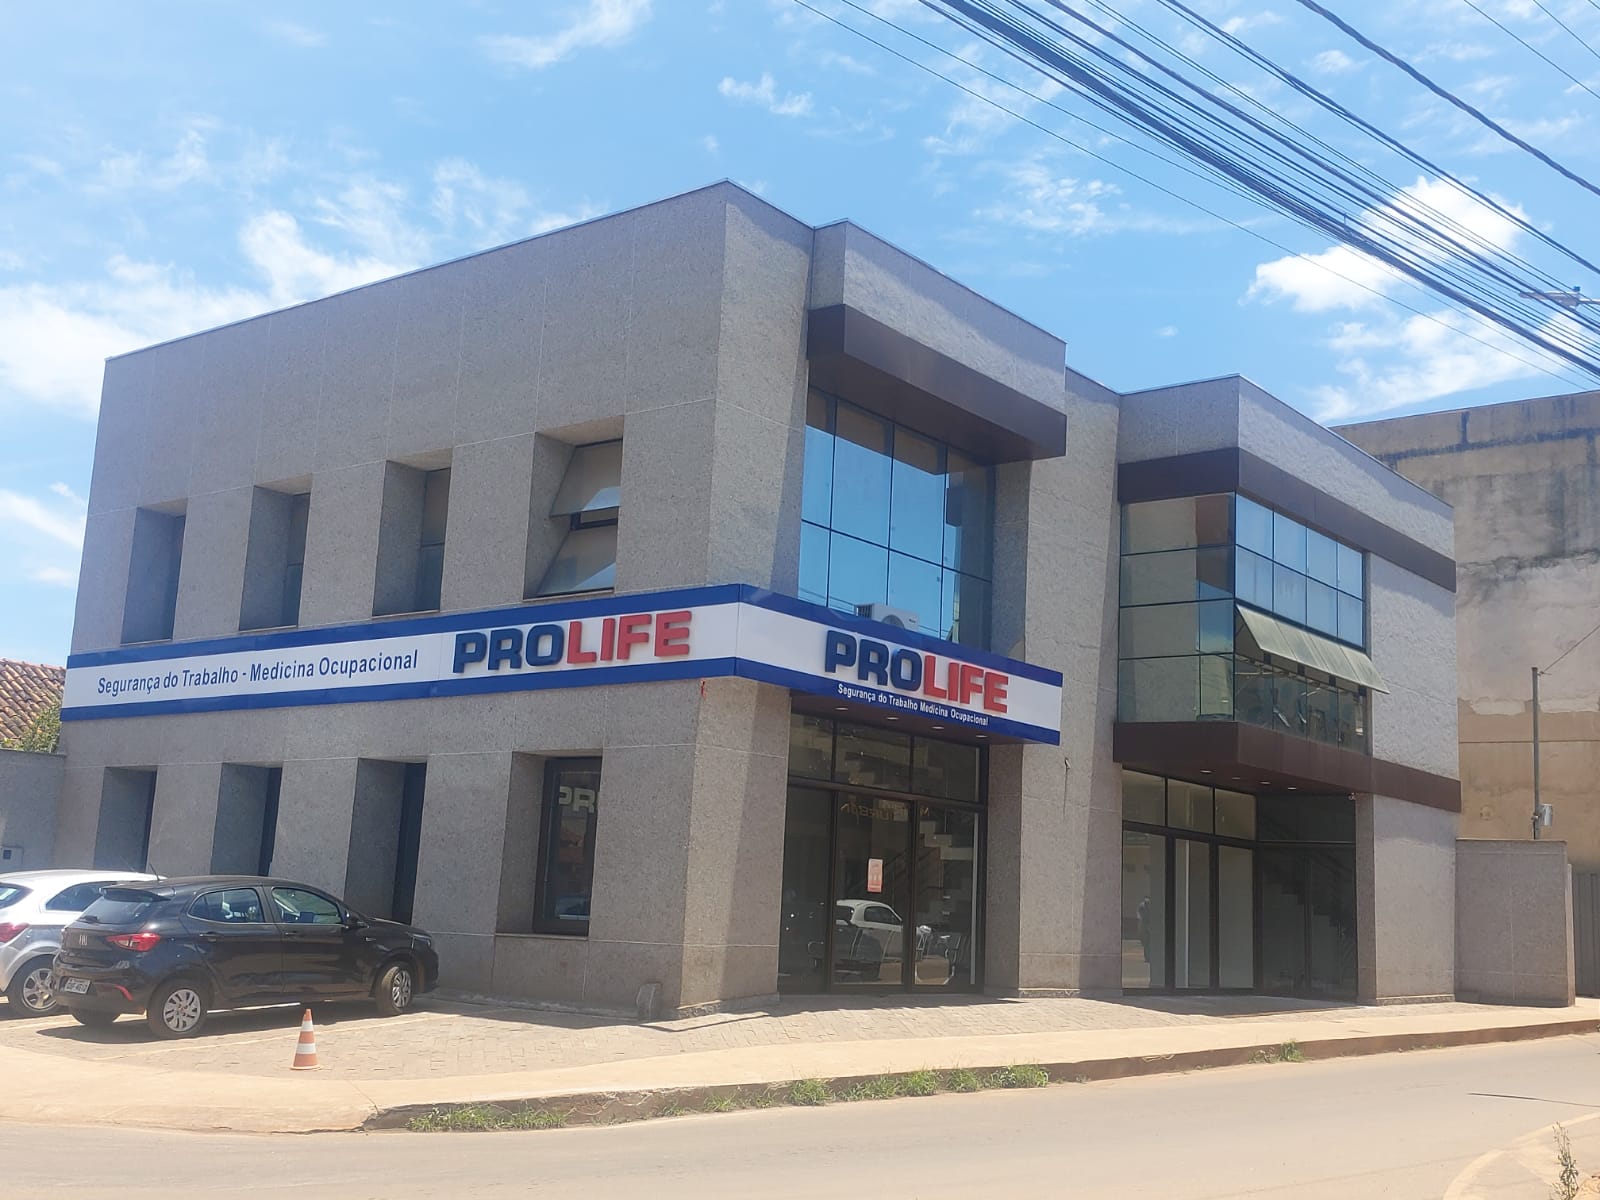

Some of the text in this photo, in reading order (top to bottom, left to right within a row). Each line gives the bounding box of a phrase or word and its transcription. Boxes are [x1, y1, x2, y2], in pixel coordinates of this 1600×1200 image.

[452, 610, 692, 673] PROLIFE
[97, 675, 161, 697] Segurança
[163, 672, 178, 689] do
[182, 666, 239, 687] Trabalho
[249, 660, 314, 682] Medicina
[319, 649, 418, 678] Ocupacional
[825, 630, 1009, 713] PROLIFE
[838, 684, 988, 726] Segurança do Trabalho Medicina Ocupacional
